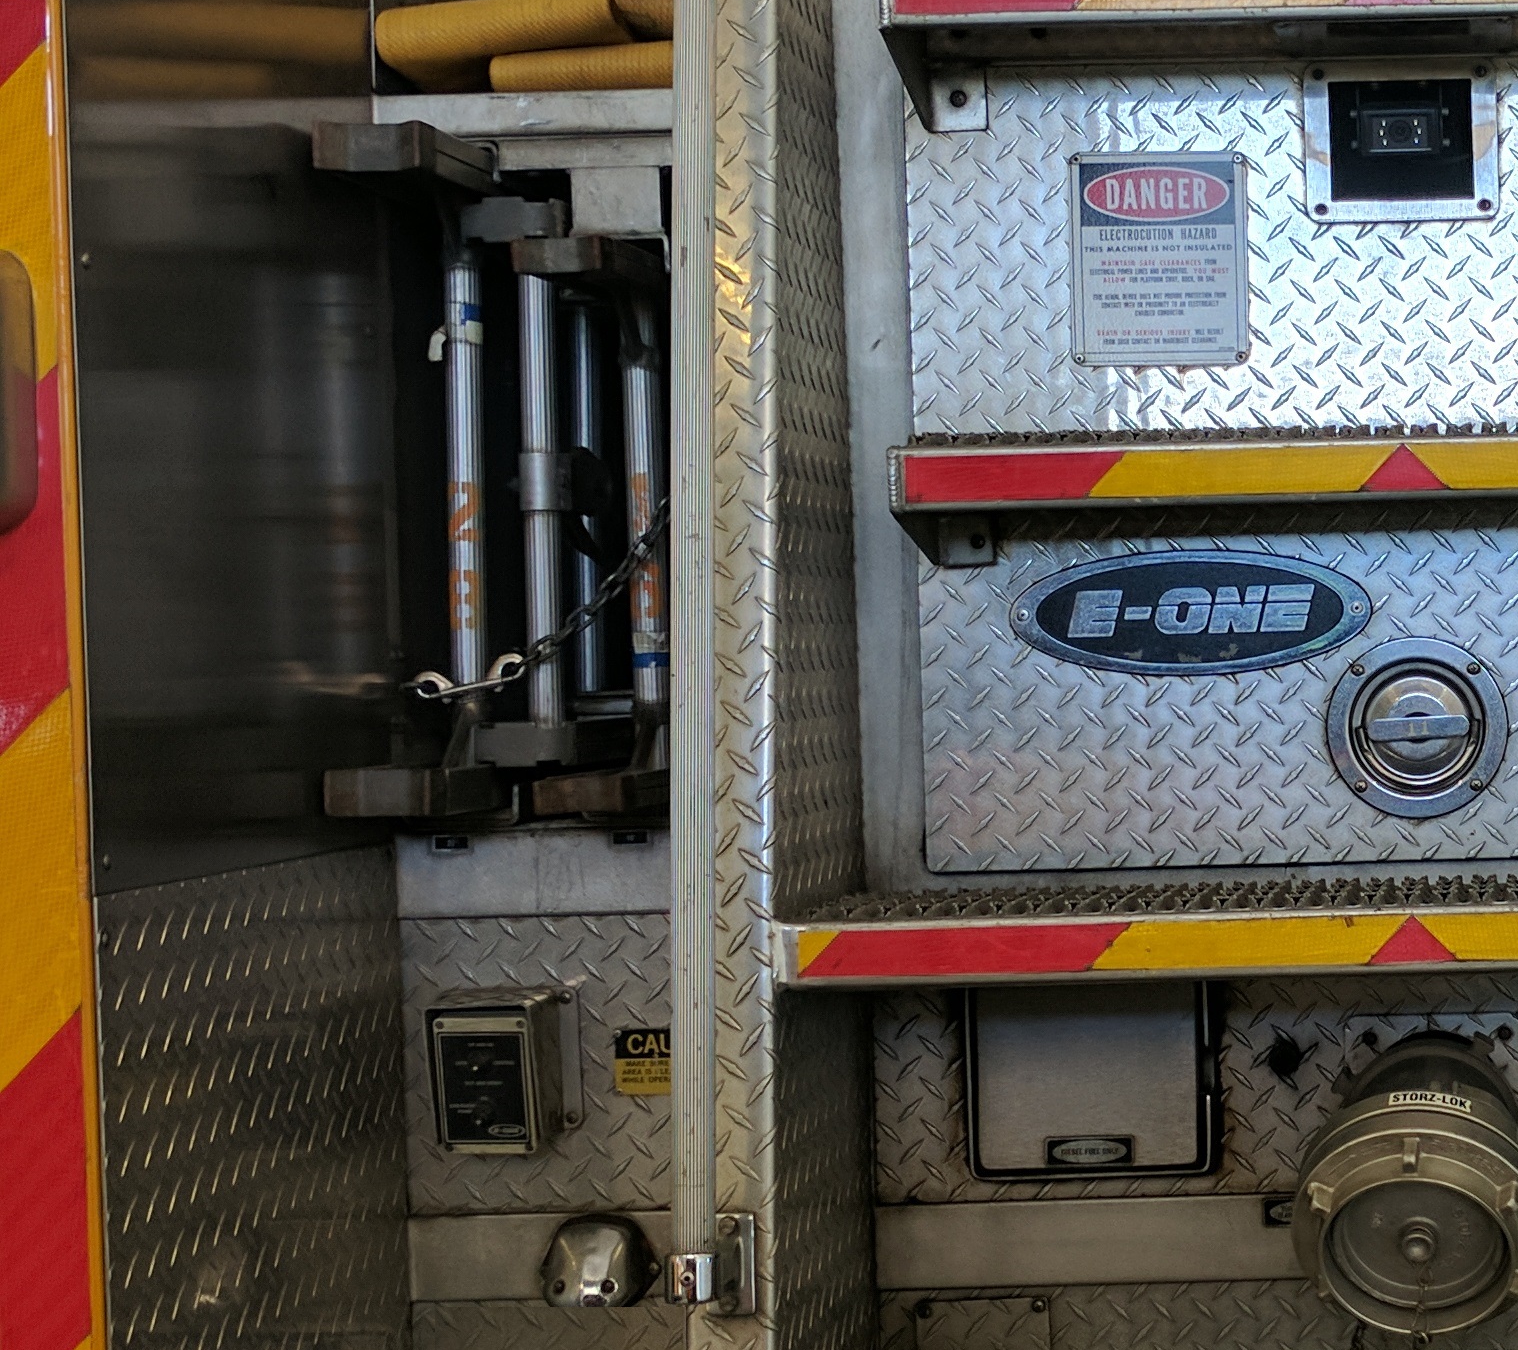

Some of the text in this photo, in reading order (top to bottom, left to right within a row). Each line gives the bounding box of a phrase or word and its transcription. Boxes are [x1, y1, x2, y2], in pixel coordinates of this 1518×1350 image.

[1105, 178, 1207, 210] DANGER
[1099, 228, 1217, 241] ELECTROCUTION HAZARD
[1067, 583, 1315, 638] E-ONE
[1407, 721, 1429, 735] 11
[1392, 1092, 1468, 1110] STORZ-LOK
